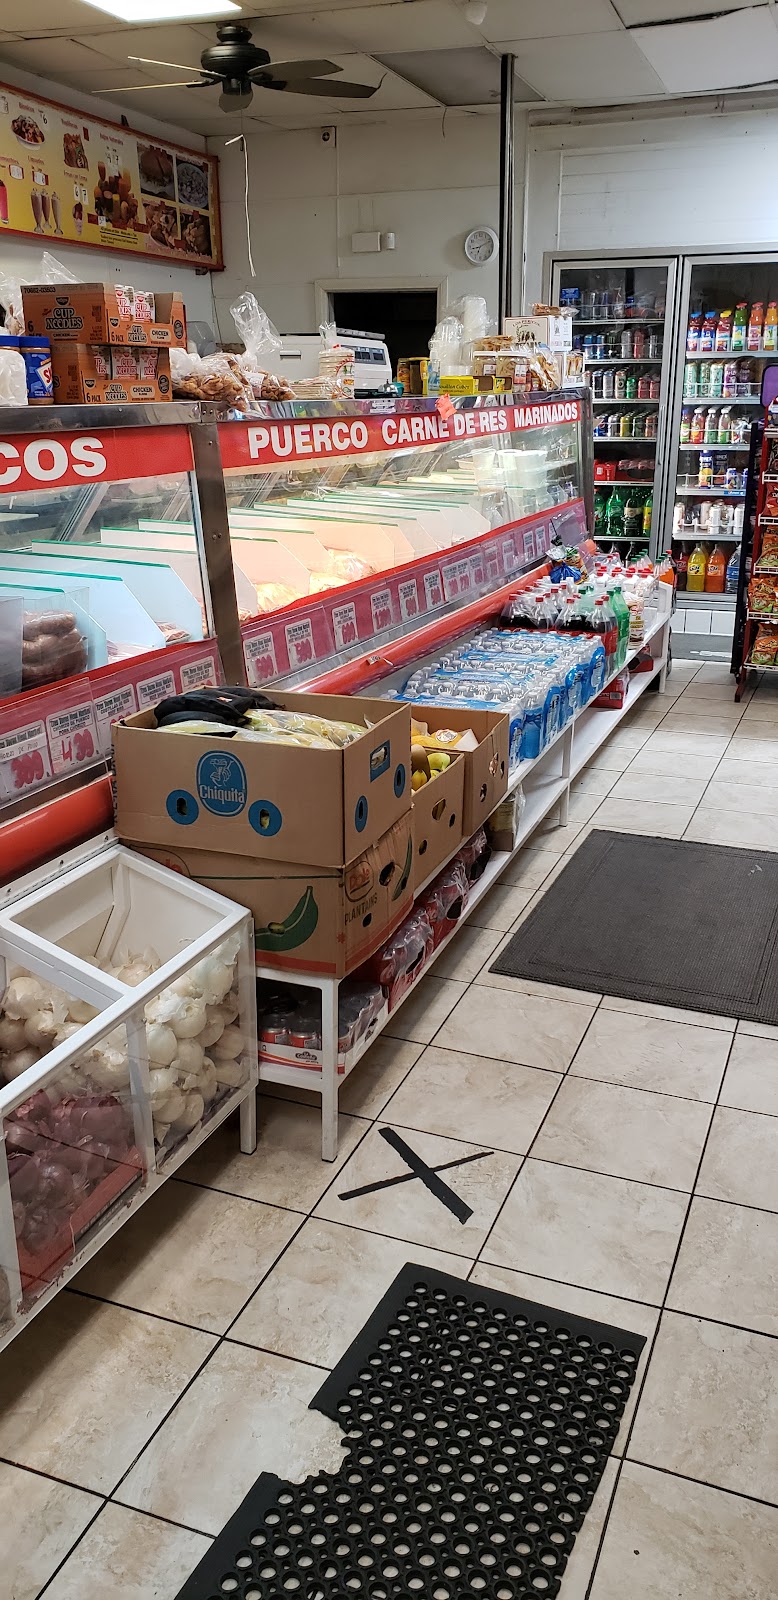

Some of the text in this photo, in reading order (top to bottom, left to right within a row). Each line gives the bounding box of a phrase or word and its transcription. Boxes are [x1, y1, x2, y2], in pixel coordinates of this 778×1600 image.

[54, 308, 75, 318] CUP
[28, 320, 34, 332] 6
[46, 319, 82, 329] NOODLES
[247, 401, 579, 459] PUERCO CARNE DE RES MARINADOS
[200, 783, 245, 805] Chiquita
[344, 891, 379, 927] PLANTAINS
